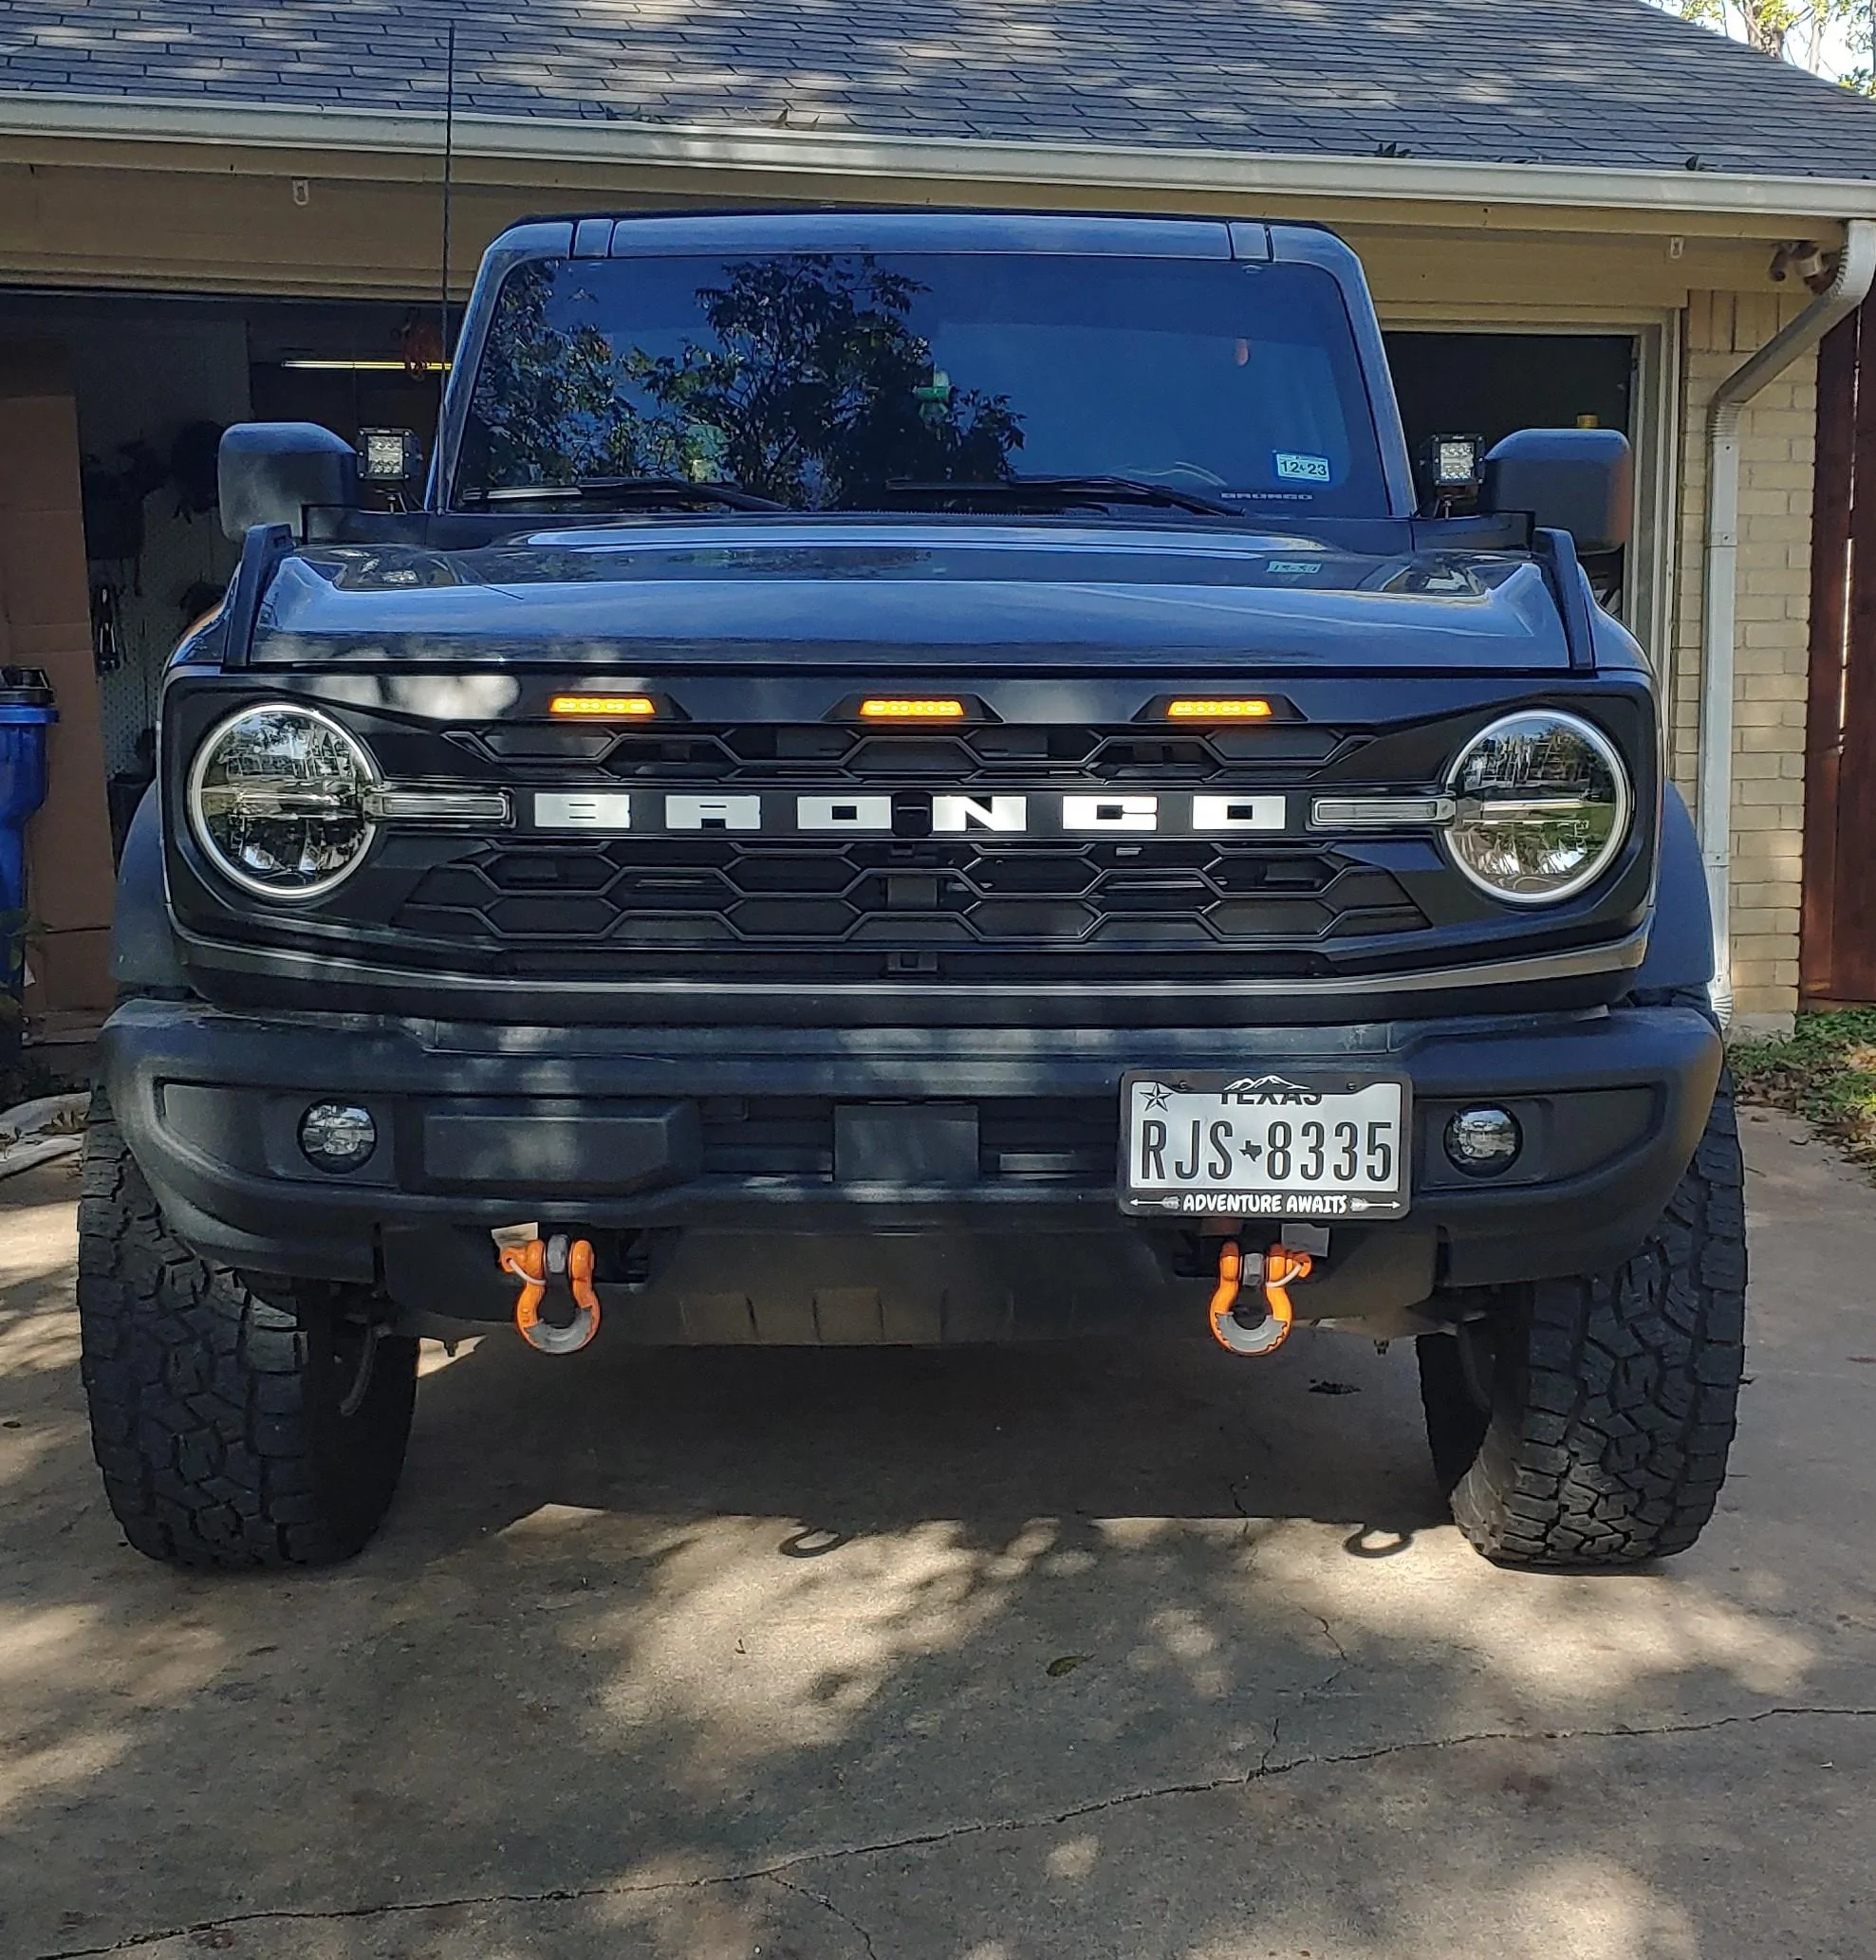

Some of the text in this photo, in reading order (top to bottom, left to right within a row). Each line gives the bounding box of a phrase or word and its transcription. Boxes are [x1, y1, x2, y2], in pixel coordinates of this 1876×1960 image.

[1280, 460, 1328, 475] 12 23
[534, 793, 1287, 832] BRONCO
[1141, 1119, 1392, 1182] RJS 8335
[1182, 1193, 1347, 1214] ADVENTURE AWAITS
